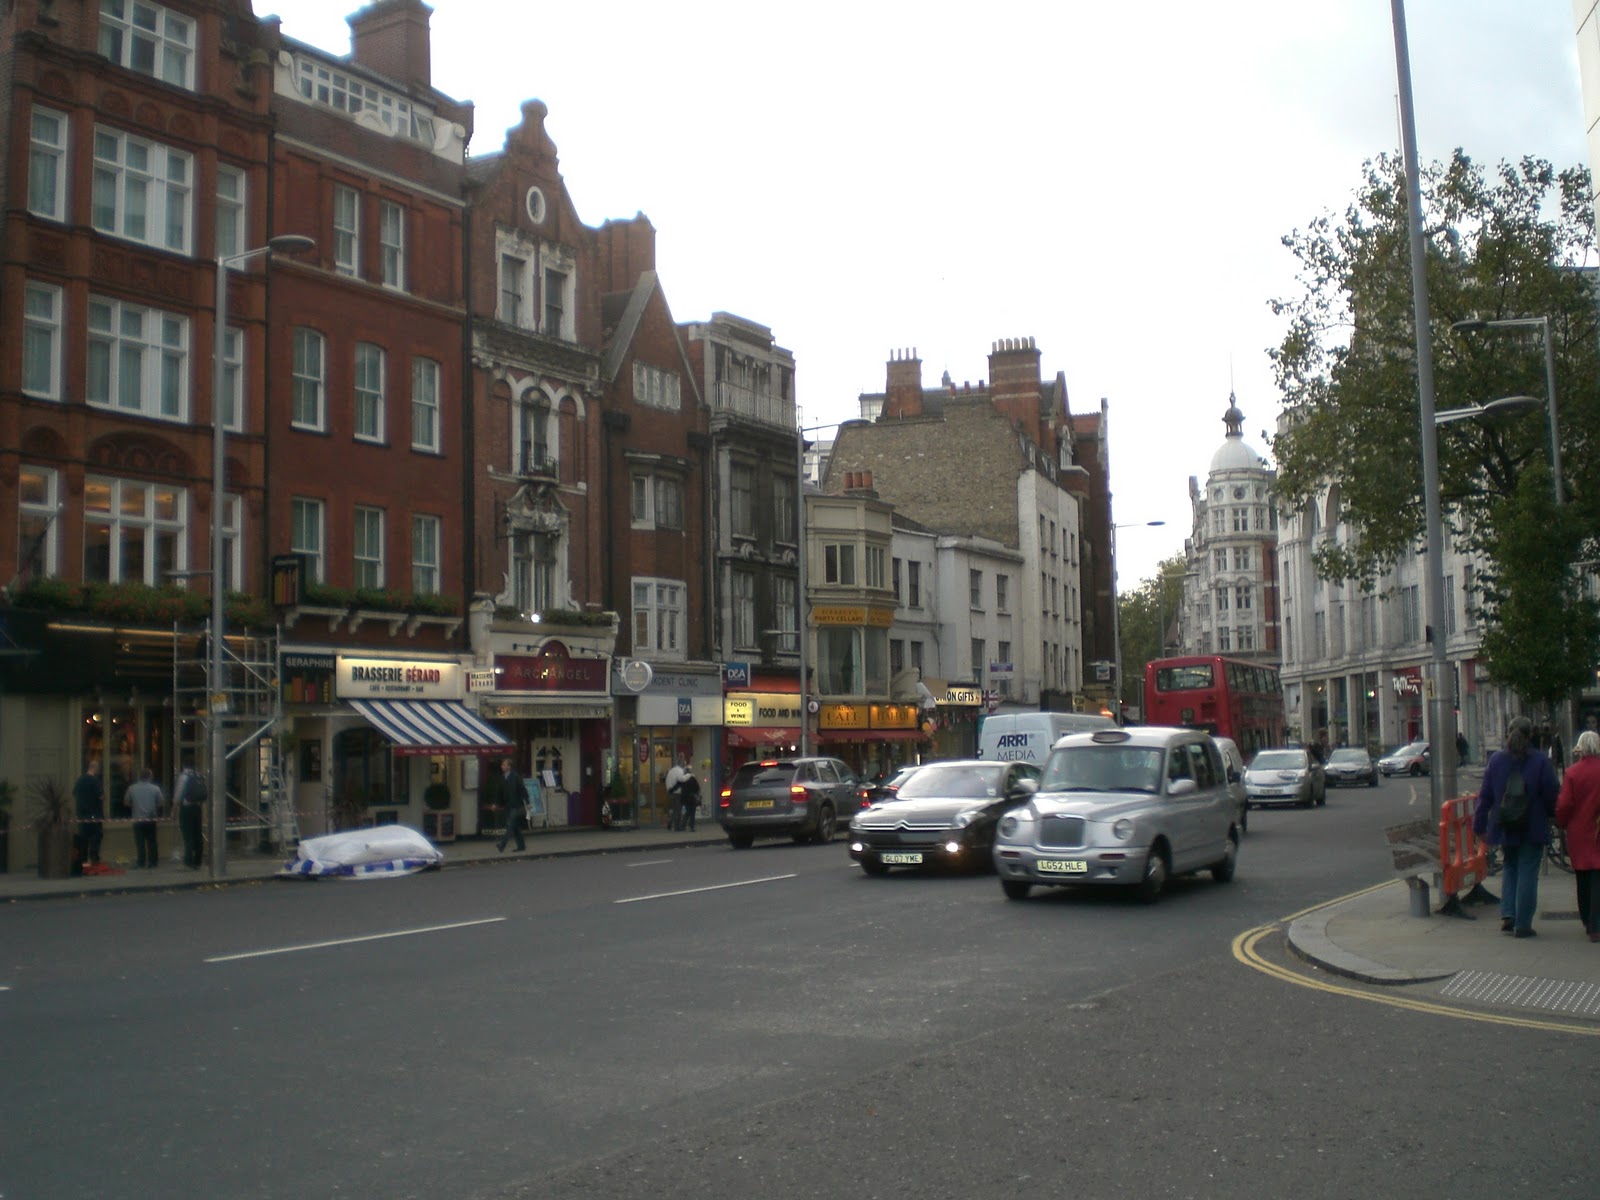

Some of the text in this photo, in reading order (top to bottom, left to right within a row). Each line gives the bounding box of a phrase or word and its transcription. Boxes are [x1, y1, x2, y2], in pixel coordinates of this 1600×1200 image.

[285, 657, 335, 668] SERAPHINE
[352, 665, 440, 683] BRASSERIE GÉRARD
[957, 692, 974, 702] GIFTS
[759, 708, 776, 718] FOOD
[778, 709, 790, 718] AND
[996, 733, 1028, 748] ARRI
[997, 750, 1036, 761] MEDIA
[1040, 860, 1083, 870] LG52 HLE
